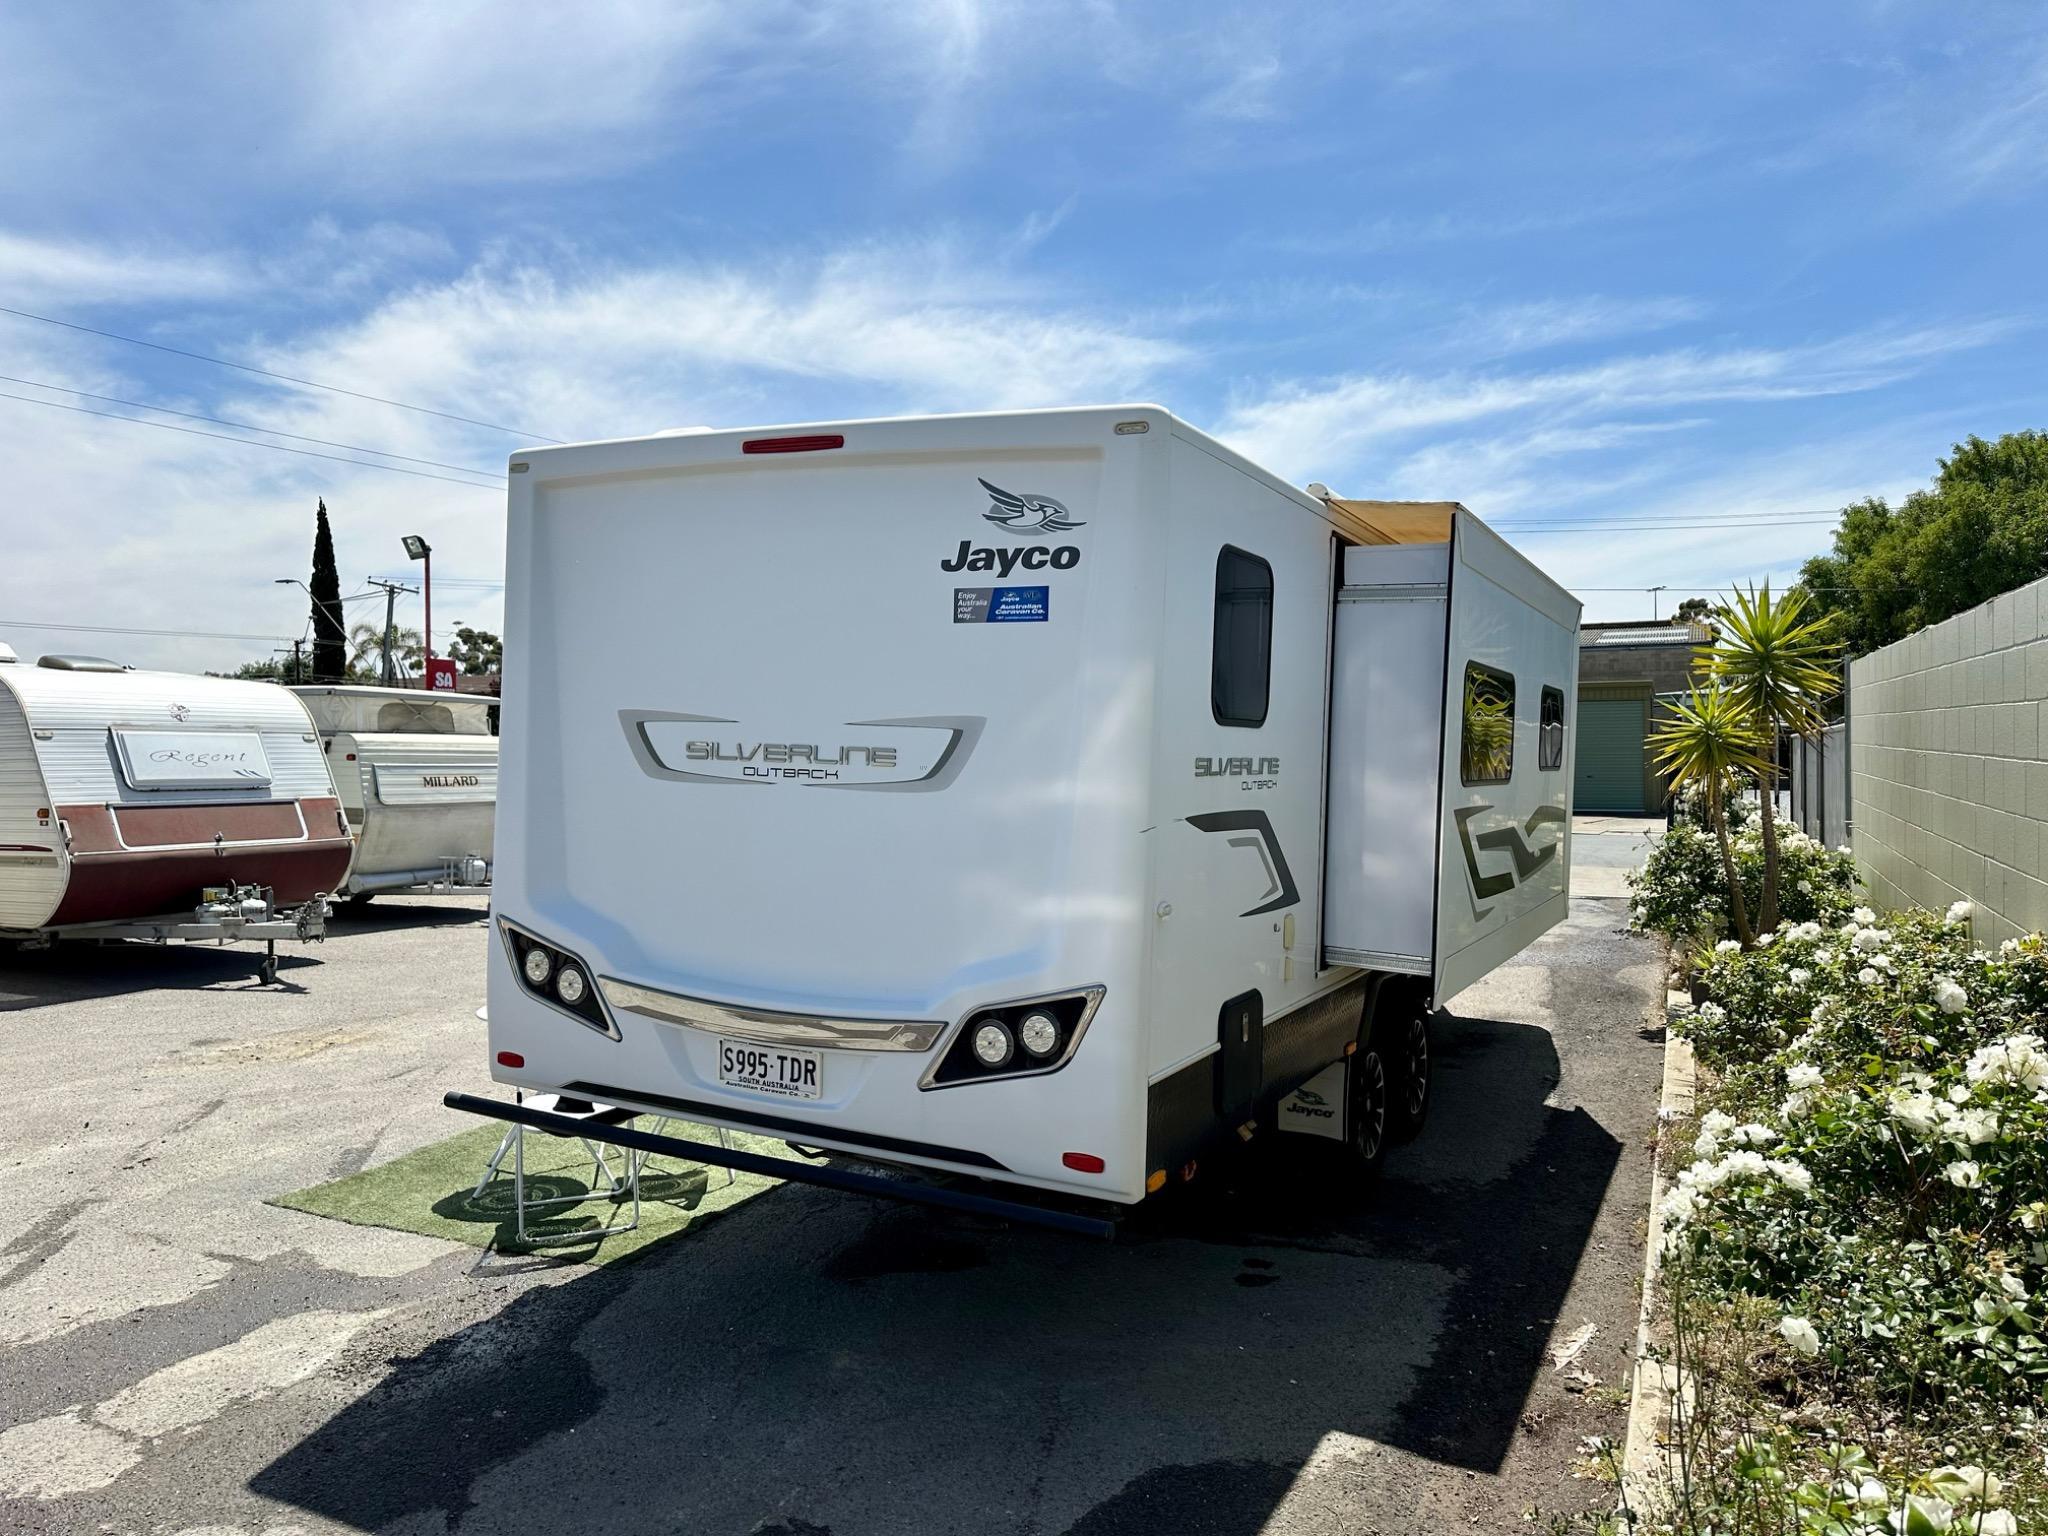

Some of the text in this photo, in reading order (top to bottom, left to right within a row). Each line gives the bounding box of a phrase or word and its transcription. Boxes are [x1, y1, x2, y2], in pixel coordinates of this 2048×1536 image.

[941, 540, 1081, 578] Jayco
[957, 592, 977, 600] Enjoy
[435, 671, 453, 688] SA
[150, 750, 247, 768] Regent
[685, 740, 897, 768] SILVERLINE
[743, 766, 839, 780] OUTBACK
[1194, 757, 1280, 777] SILVERLINE
[422, 775, 479, 788] MILLARD
[1241, 780, 1277, 790] OUTBACK
[725, 1080, 758, 1090] Australian
[760, 1086, 787, 1095] Caravan
[738, 1076, 800, 1092] SOUTH AUSTRALIA
[1286, 1102, 1332, 1118] Jayco
